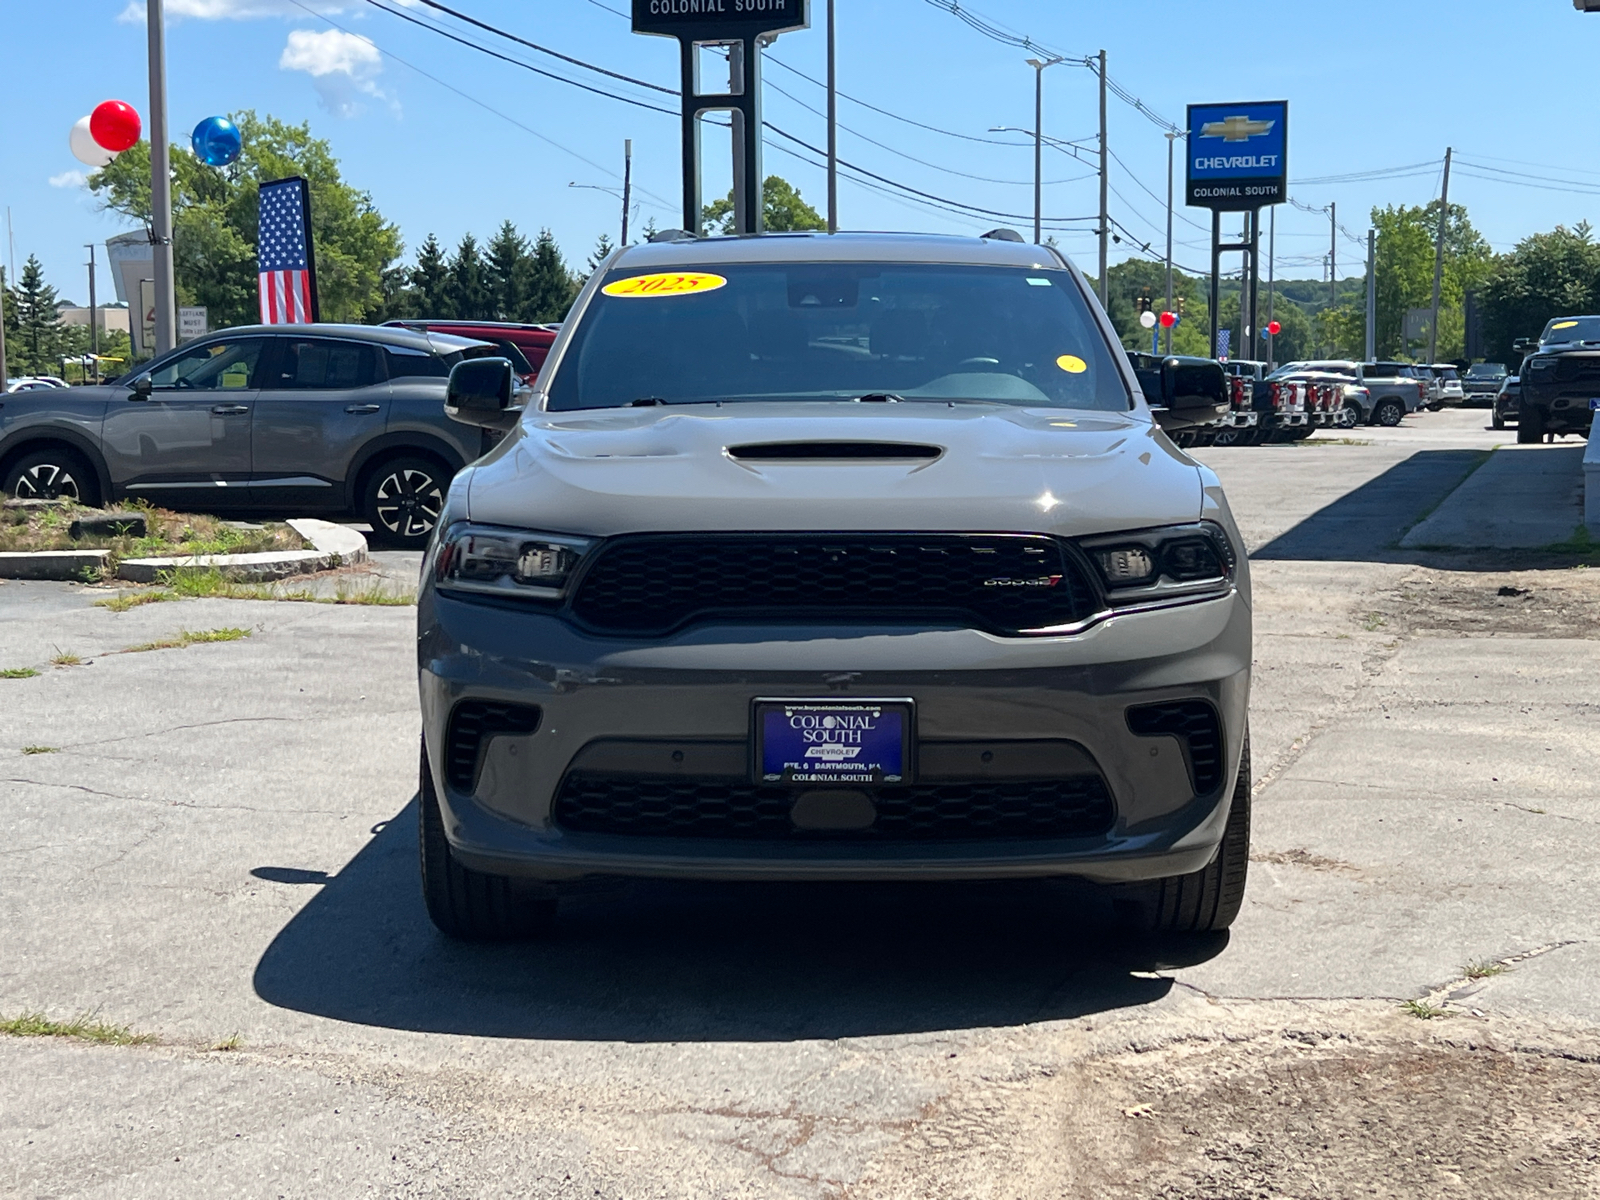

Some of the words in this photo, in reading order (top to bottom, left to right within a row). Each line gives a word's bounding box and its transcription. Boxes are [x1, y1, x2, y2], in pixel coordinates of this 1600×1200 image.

[650, 0, 726, 14] COLONIAL
[735, 0, 786, 12] SOUTH
[1194, 154, 1278, 169] CHEVROLET
[1193, 187, 1242, 198] COLONIAL
[1245, 185, 1278, 196] SOUTH
[619, 276, 707, 294] 2025
[790, 715, 875, 729] COLONIAL
[803, 729, 861, 742] SOUTH
[810, 748, 855, 756] CHEVROLET
[803, 762, 809, 770] 6
[815, 762, 867, 771] DARTMOUTH,
[792, 773, 839, 781] COLONIAL
[841, 774, 872, 782] SOUTH
